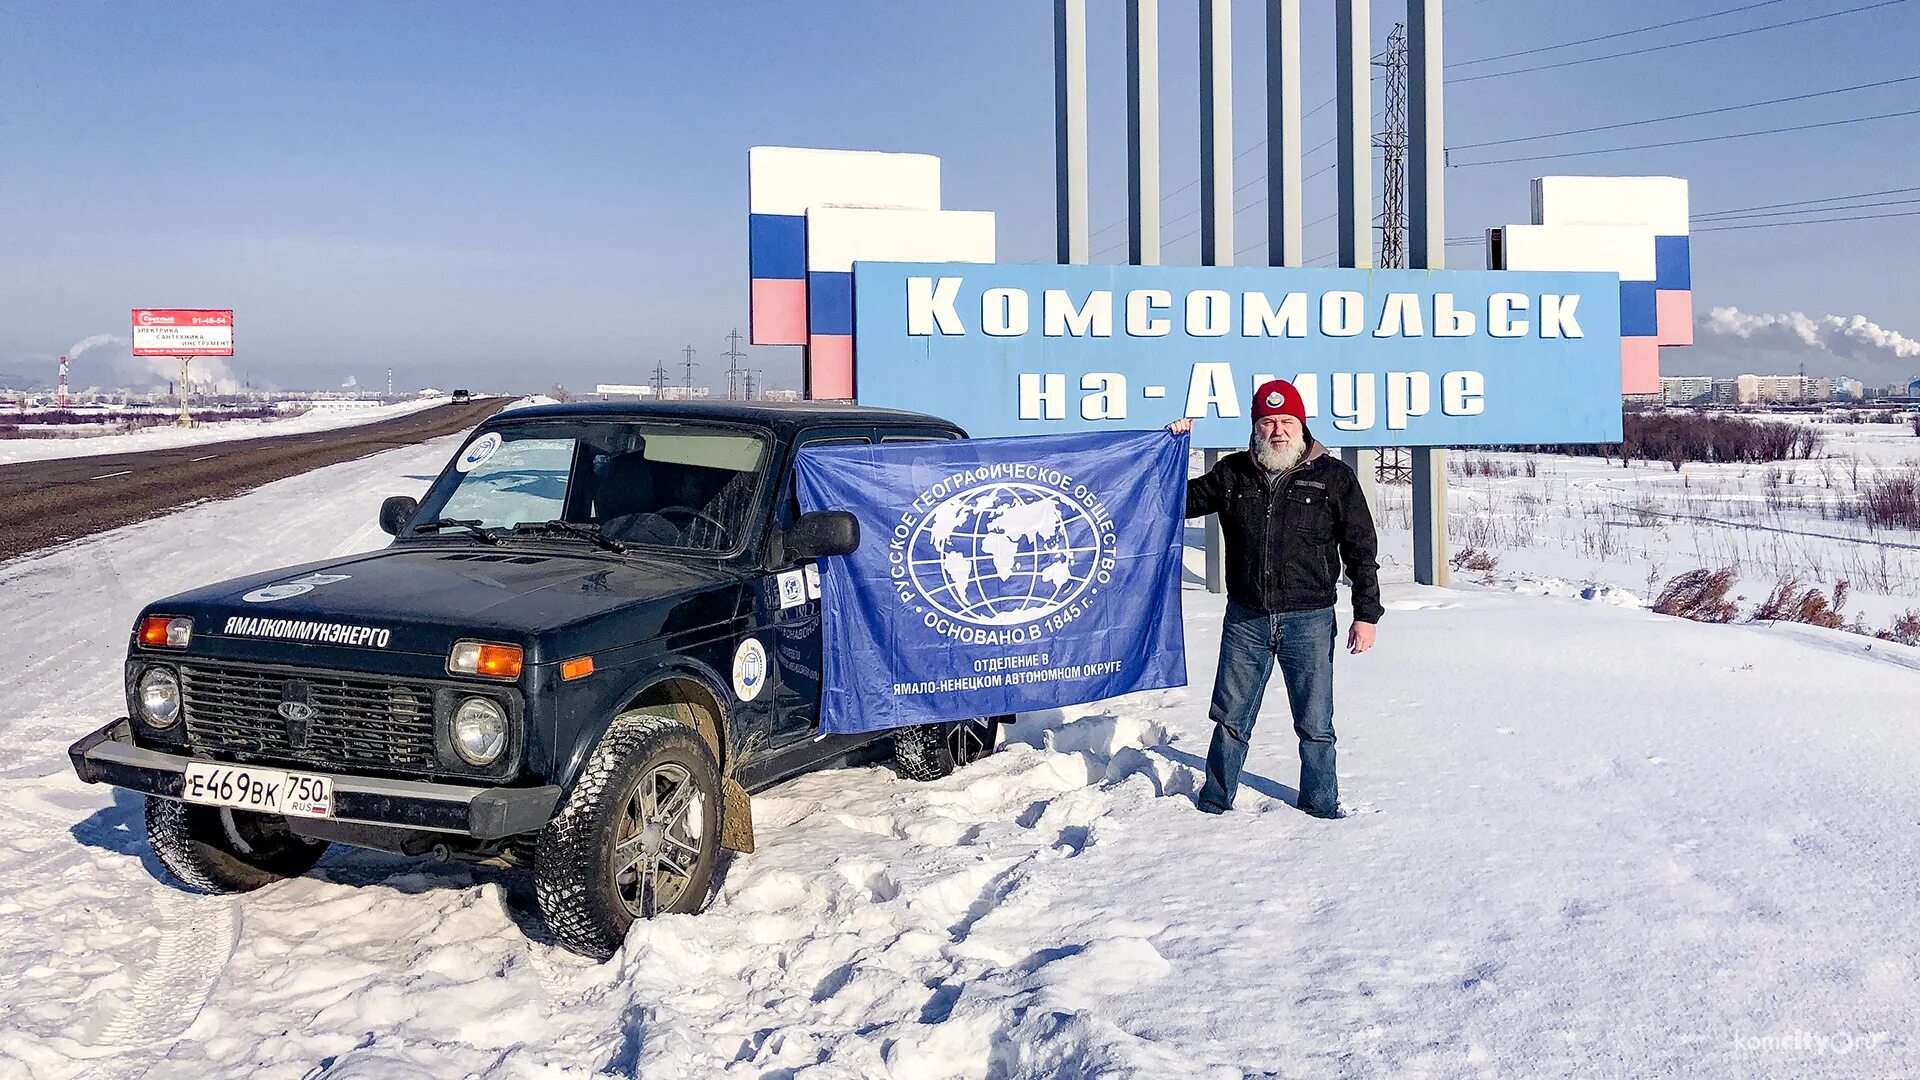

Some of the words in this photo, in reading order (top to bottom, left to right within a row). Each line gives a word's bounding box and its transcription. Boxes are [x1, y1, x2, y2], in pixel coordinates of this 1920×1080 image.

[906, 276, 1585, 338] Комсомольск
[888, 511, 918, 604] РУССКОЕ
[913, 463, 1073, 514] ГЕОГРАФИЧЕСКОЕ
[1074, 484, 1117, 584] ОБЩЕСТВО
[223, 616, 391, 648] ЯМАЛКОММУНЭНЕРГО
[923, 611, 1026, 646] ОСНОВАНО
[1028, 624, 1042, 641] В
[1044, 603, 1081, 634] 1845
[893, 674, 1003, 697] ЯМАЛО-НЕНЕЦКОМ
[1004, 665, 1082, 686] АВТОНОМНОМ
[1083, 660, 1122, 677] ОКРУГЕ
[973, 654, 1040, 673] ОТДЕЛЕНИЕ
[1041, 653, 1049, 666] В
[286, 776, 323, 801] 750
[291, 801, 312, 812] RUS
